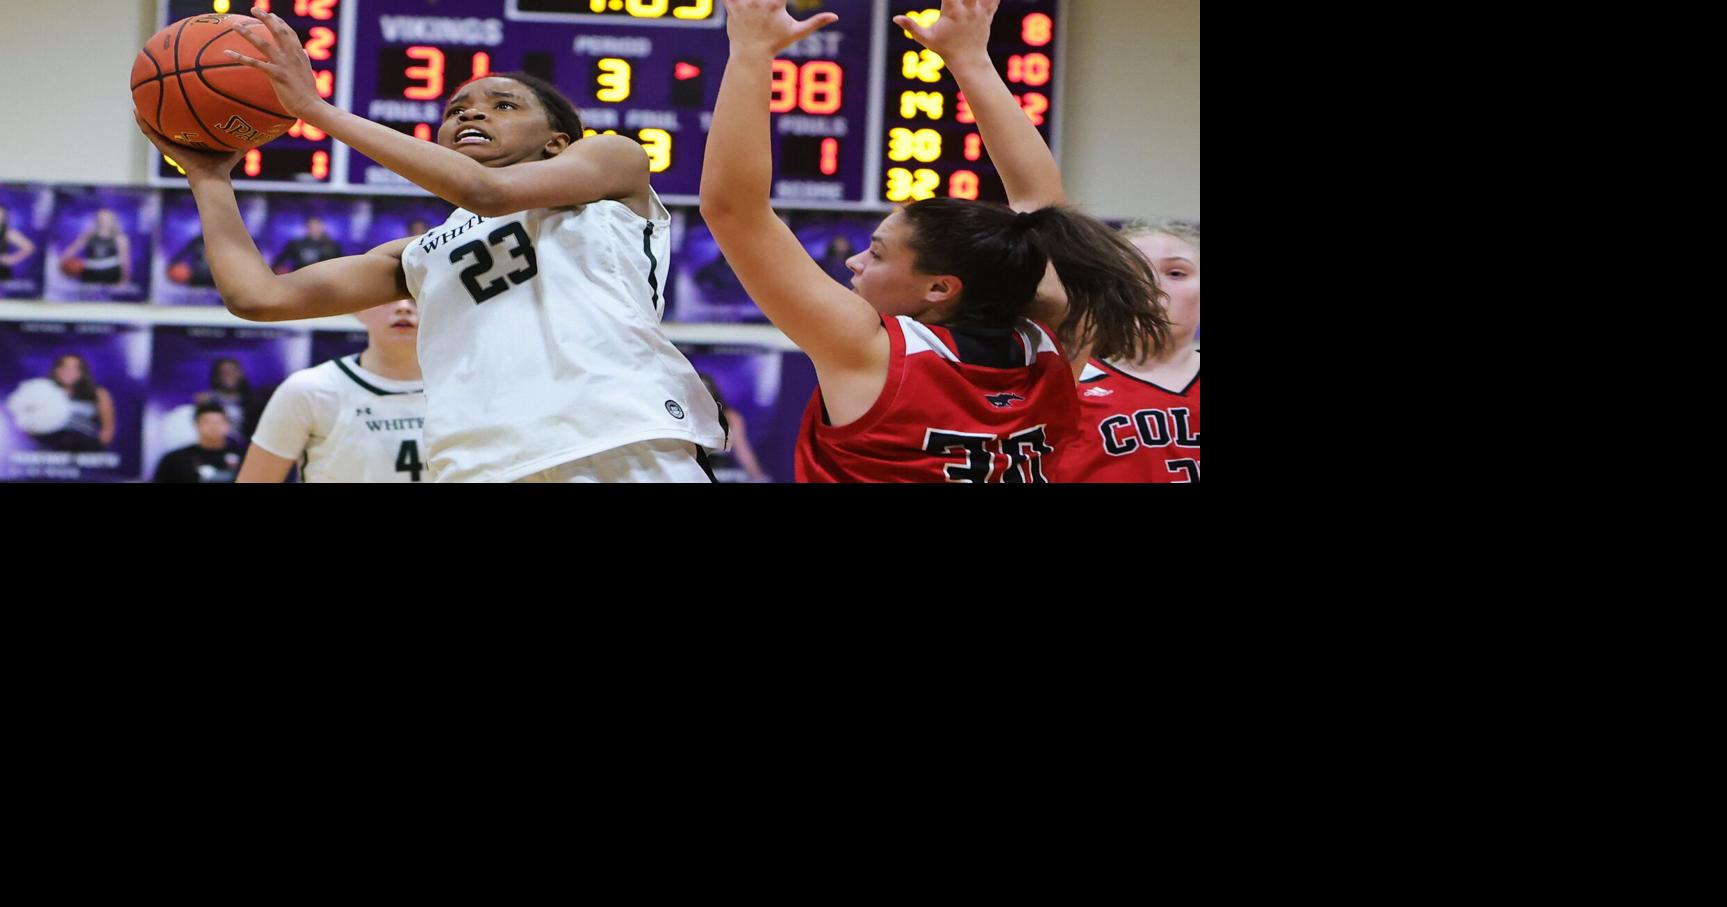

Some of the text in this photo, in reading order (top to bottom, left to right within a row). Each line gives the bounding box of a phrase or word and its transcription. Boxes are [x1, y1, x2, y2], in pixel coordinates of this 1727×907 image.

[379, 15, 503, 46] VIKINGS
[573, 35, 653, 57] PERIOD
[596, 58, 631, 102] 3
[1007, 52, 1050, 87] 10
[369, 101, 440, 123] FOULS
[777, 115, 847, 136] FOULS
[820, 137, 838, 175] 1
[888, 127, 981, 162] 30 1
[886, 167, 941, 201] 32
[449, 221, 538, 305] 23
[1098, 406, 1200, 456] COL
[395, 439, 424, 482] 4
